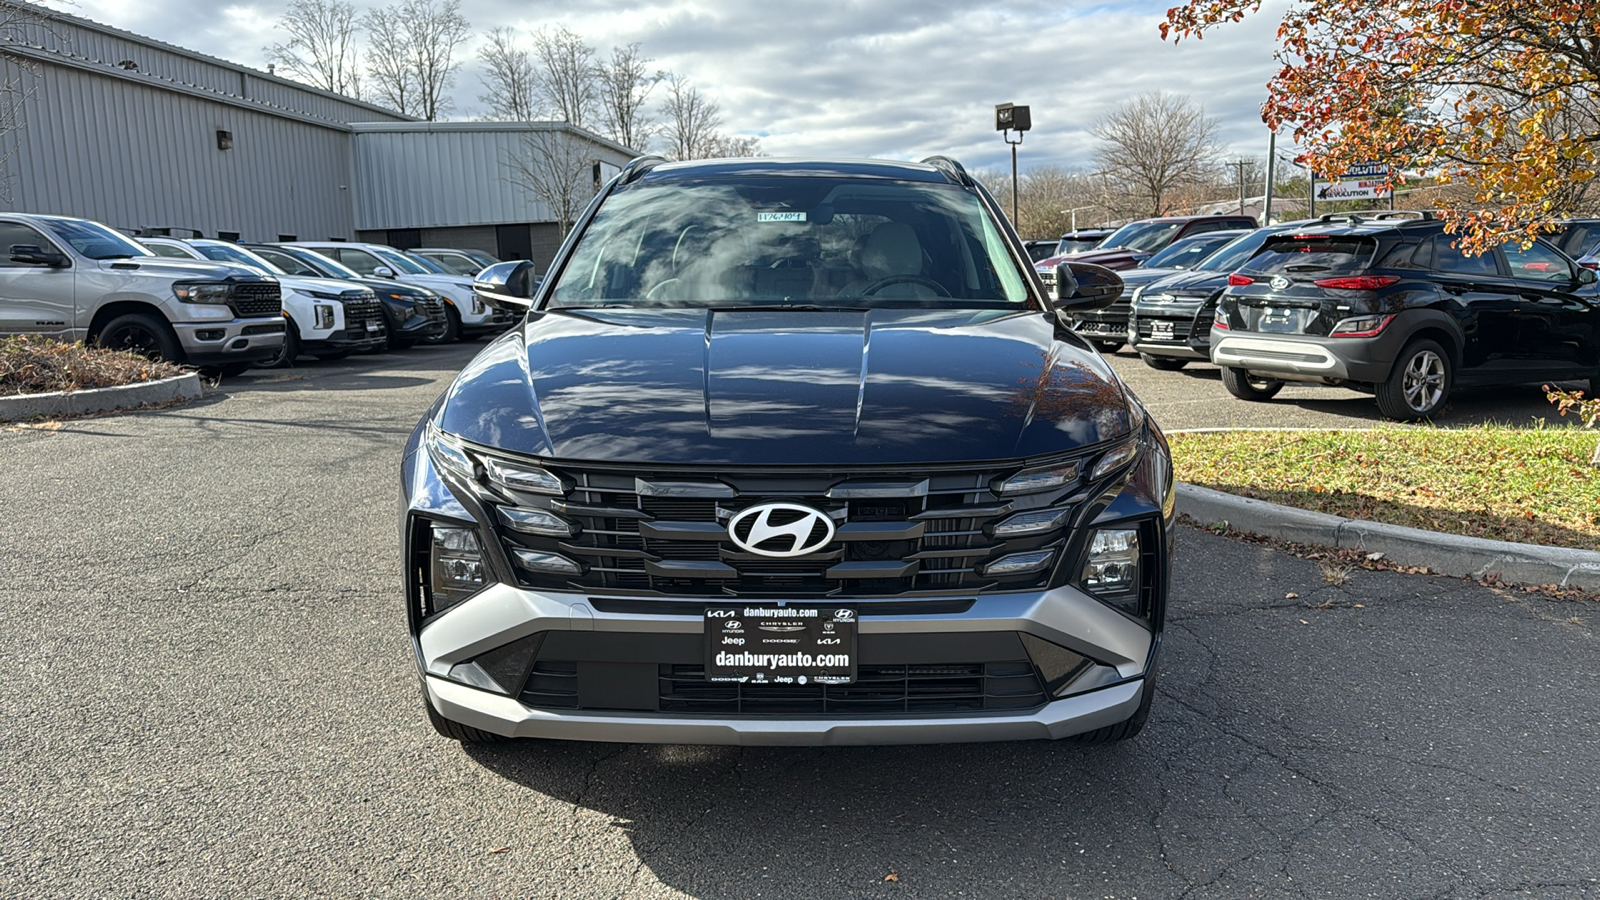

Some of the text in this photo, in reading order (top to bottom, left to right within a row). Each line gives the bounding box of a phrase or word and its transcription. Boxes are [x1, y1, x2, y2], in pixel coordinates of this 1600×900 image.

[707, 610, 736, 618] KIA
[743, 607, 818, 618] danburyauto.com
[722, 636, 745, 646] Jeep
[715, 650, 849, 670] danburyauto.com
[774, 675, 793, 684] Jeep
